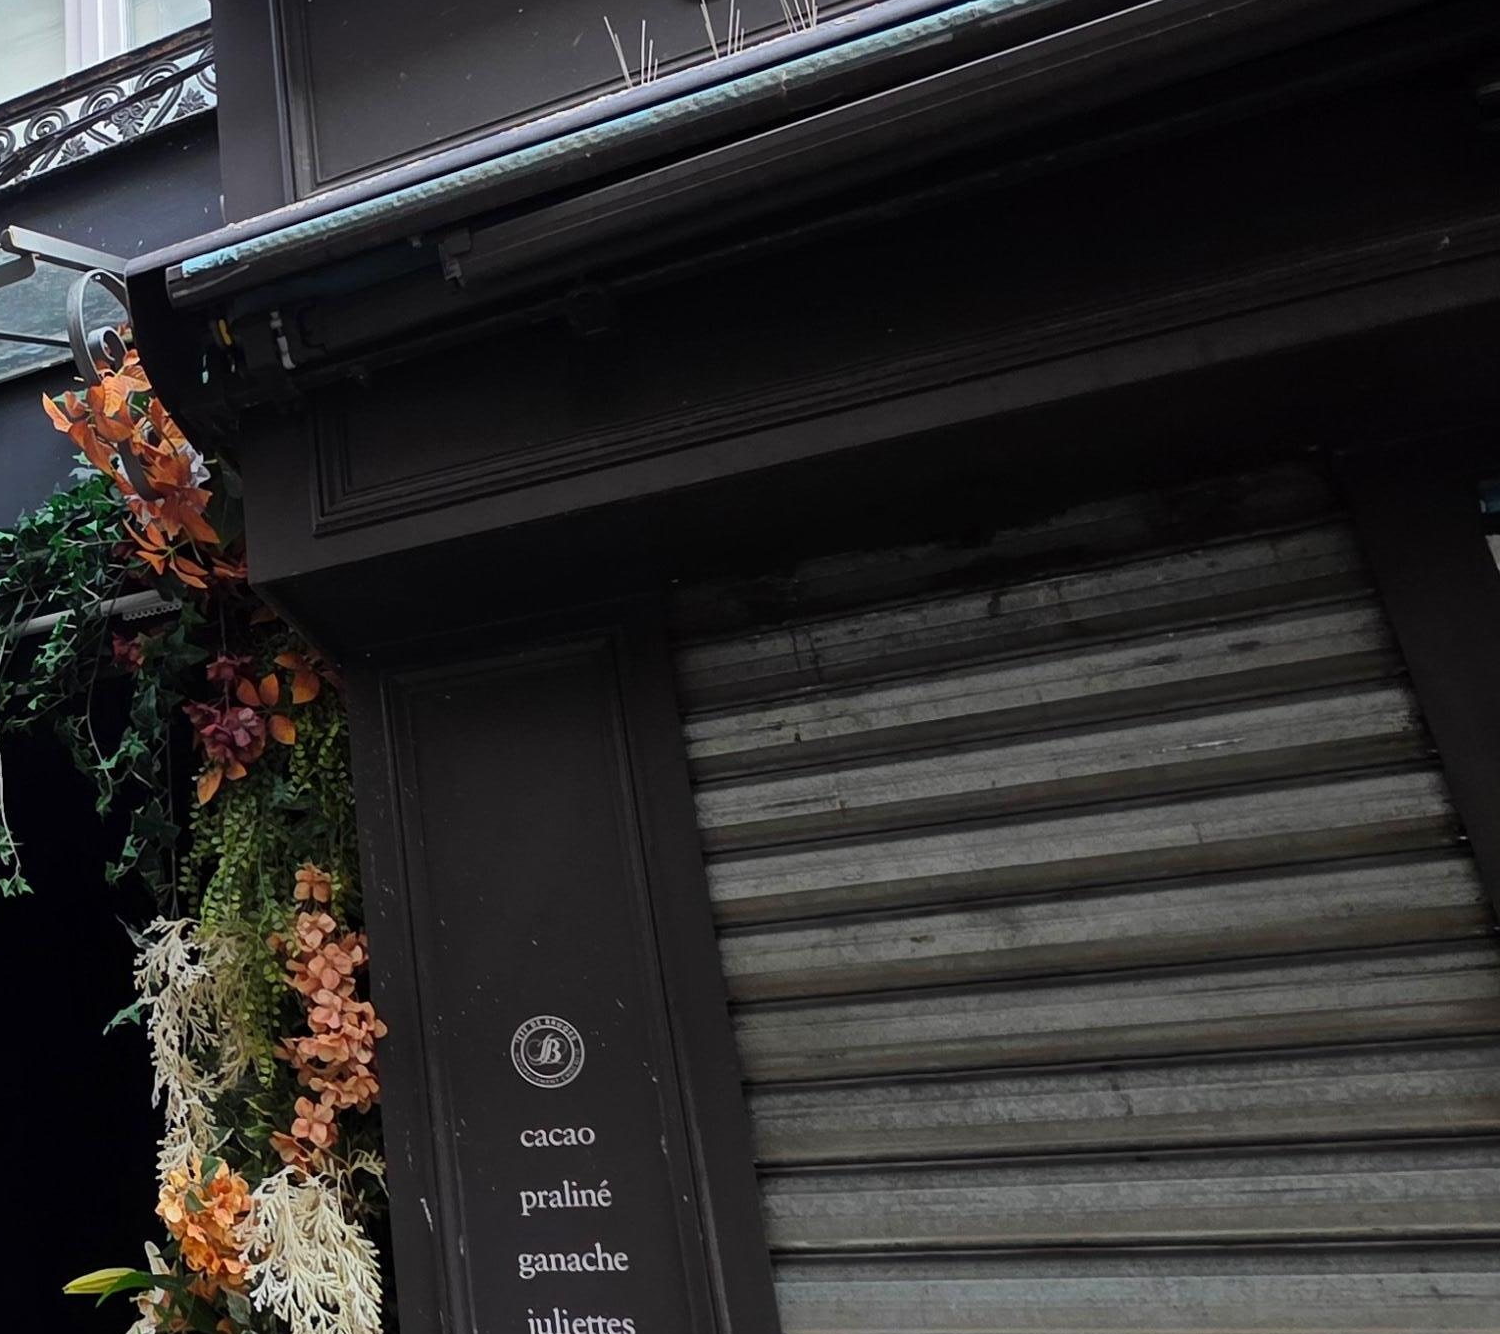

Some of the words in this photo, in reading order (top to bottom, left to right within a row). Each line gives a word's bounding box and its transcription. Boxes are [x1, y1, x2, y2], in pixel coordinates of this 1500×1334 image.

[520, 1127, 595, 1147] cacao
[520, 1180, 612, 1216] praliné
[518, 1242, 629, 1279] ganache
